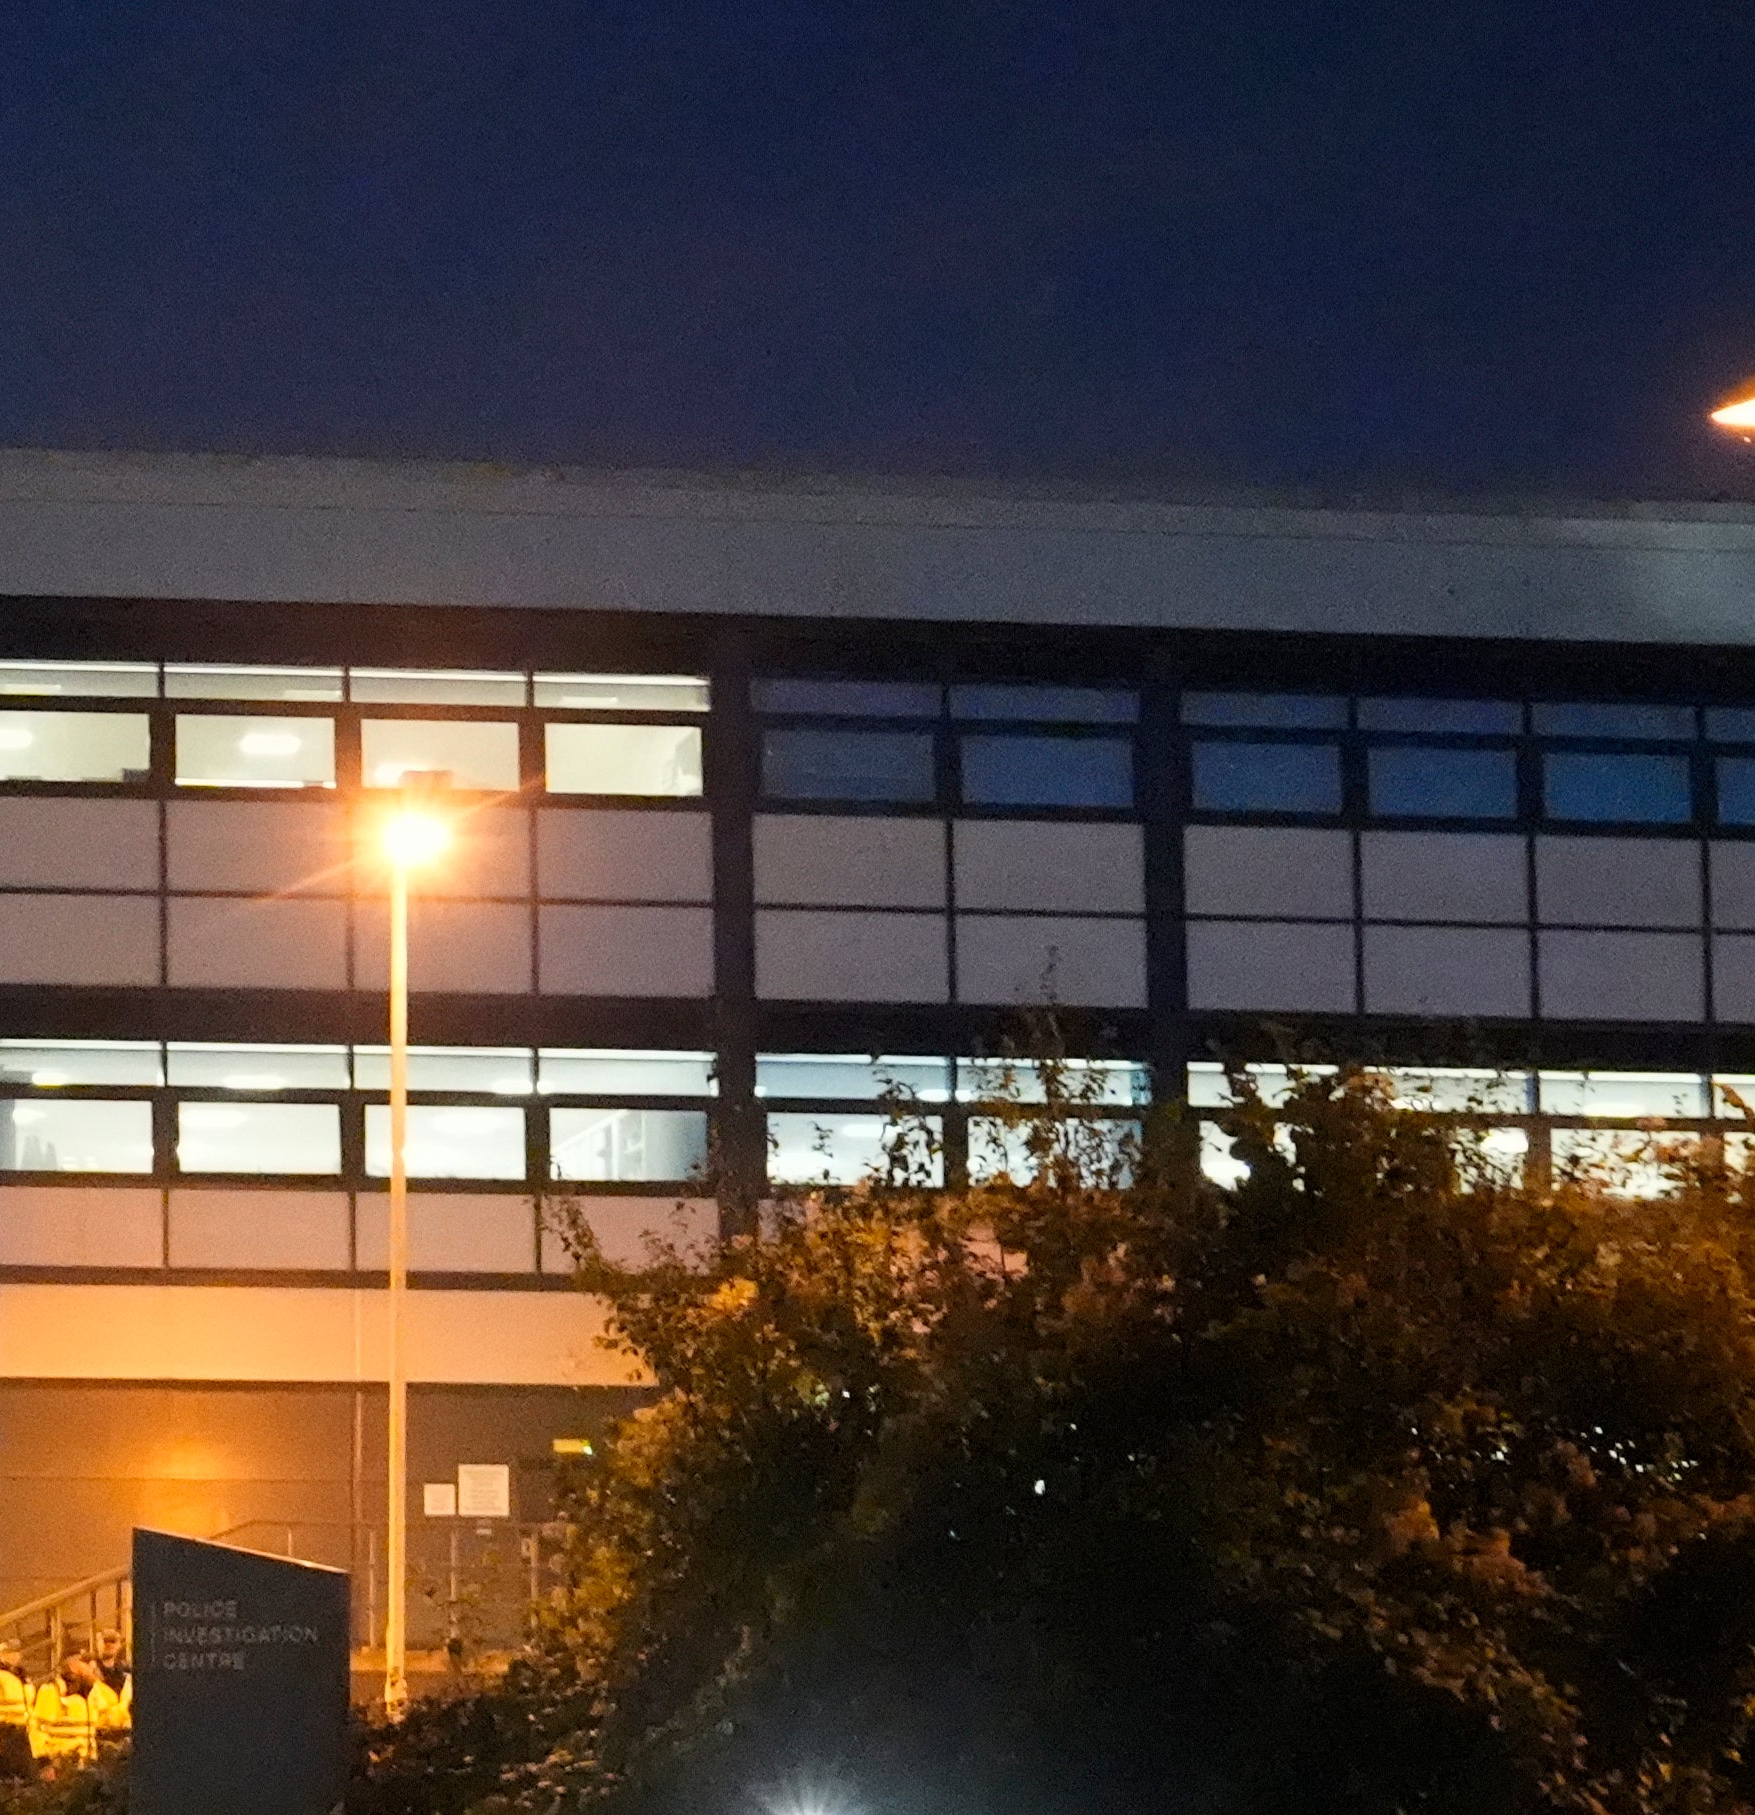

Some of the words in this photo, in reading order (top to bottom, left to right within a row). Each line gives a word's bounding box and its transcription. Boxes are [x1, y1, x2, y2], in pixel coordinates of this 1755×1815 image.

[163, 1600, 238, 1618] POLICE
[163, 1626, 319, 1645] INVESTIGATION
[163, 1651, 246, 1670] CENTRE
